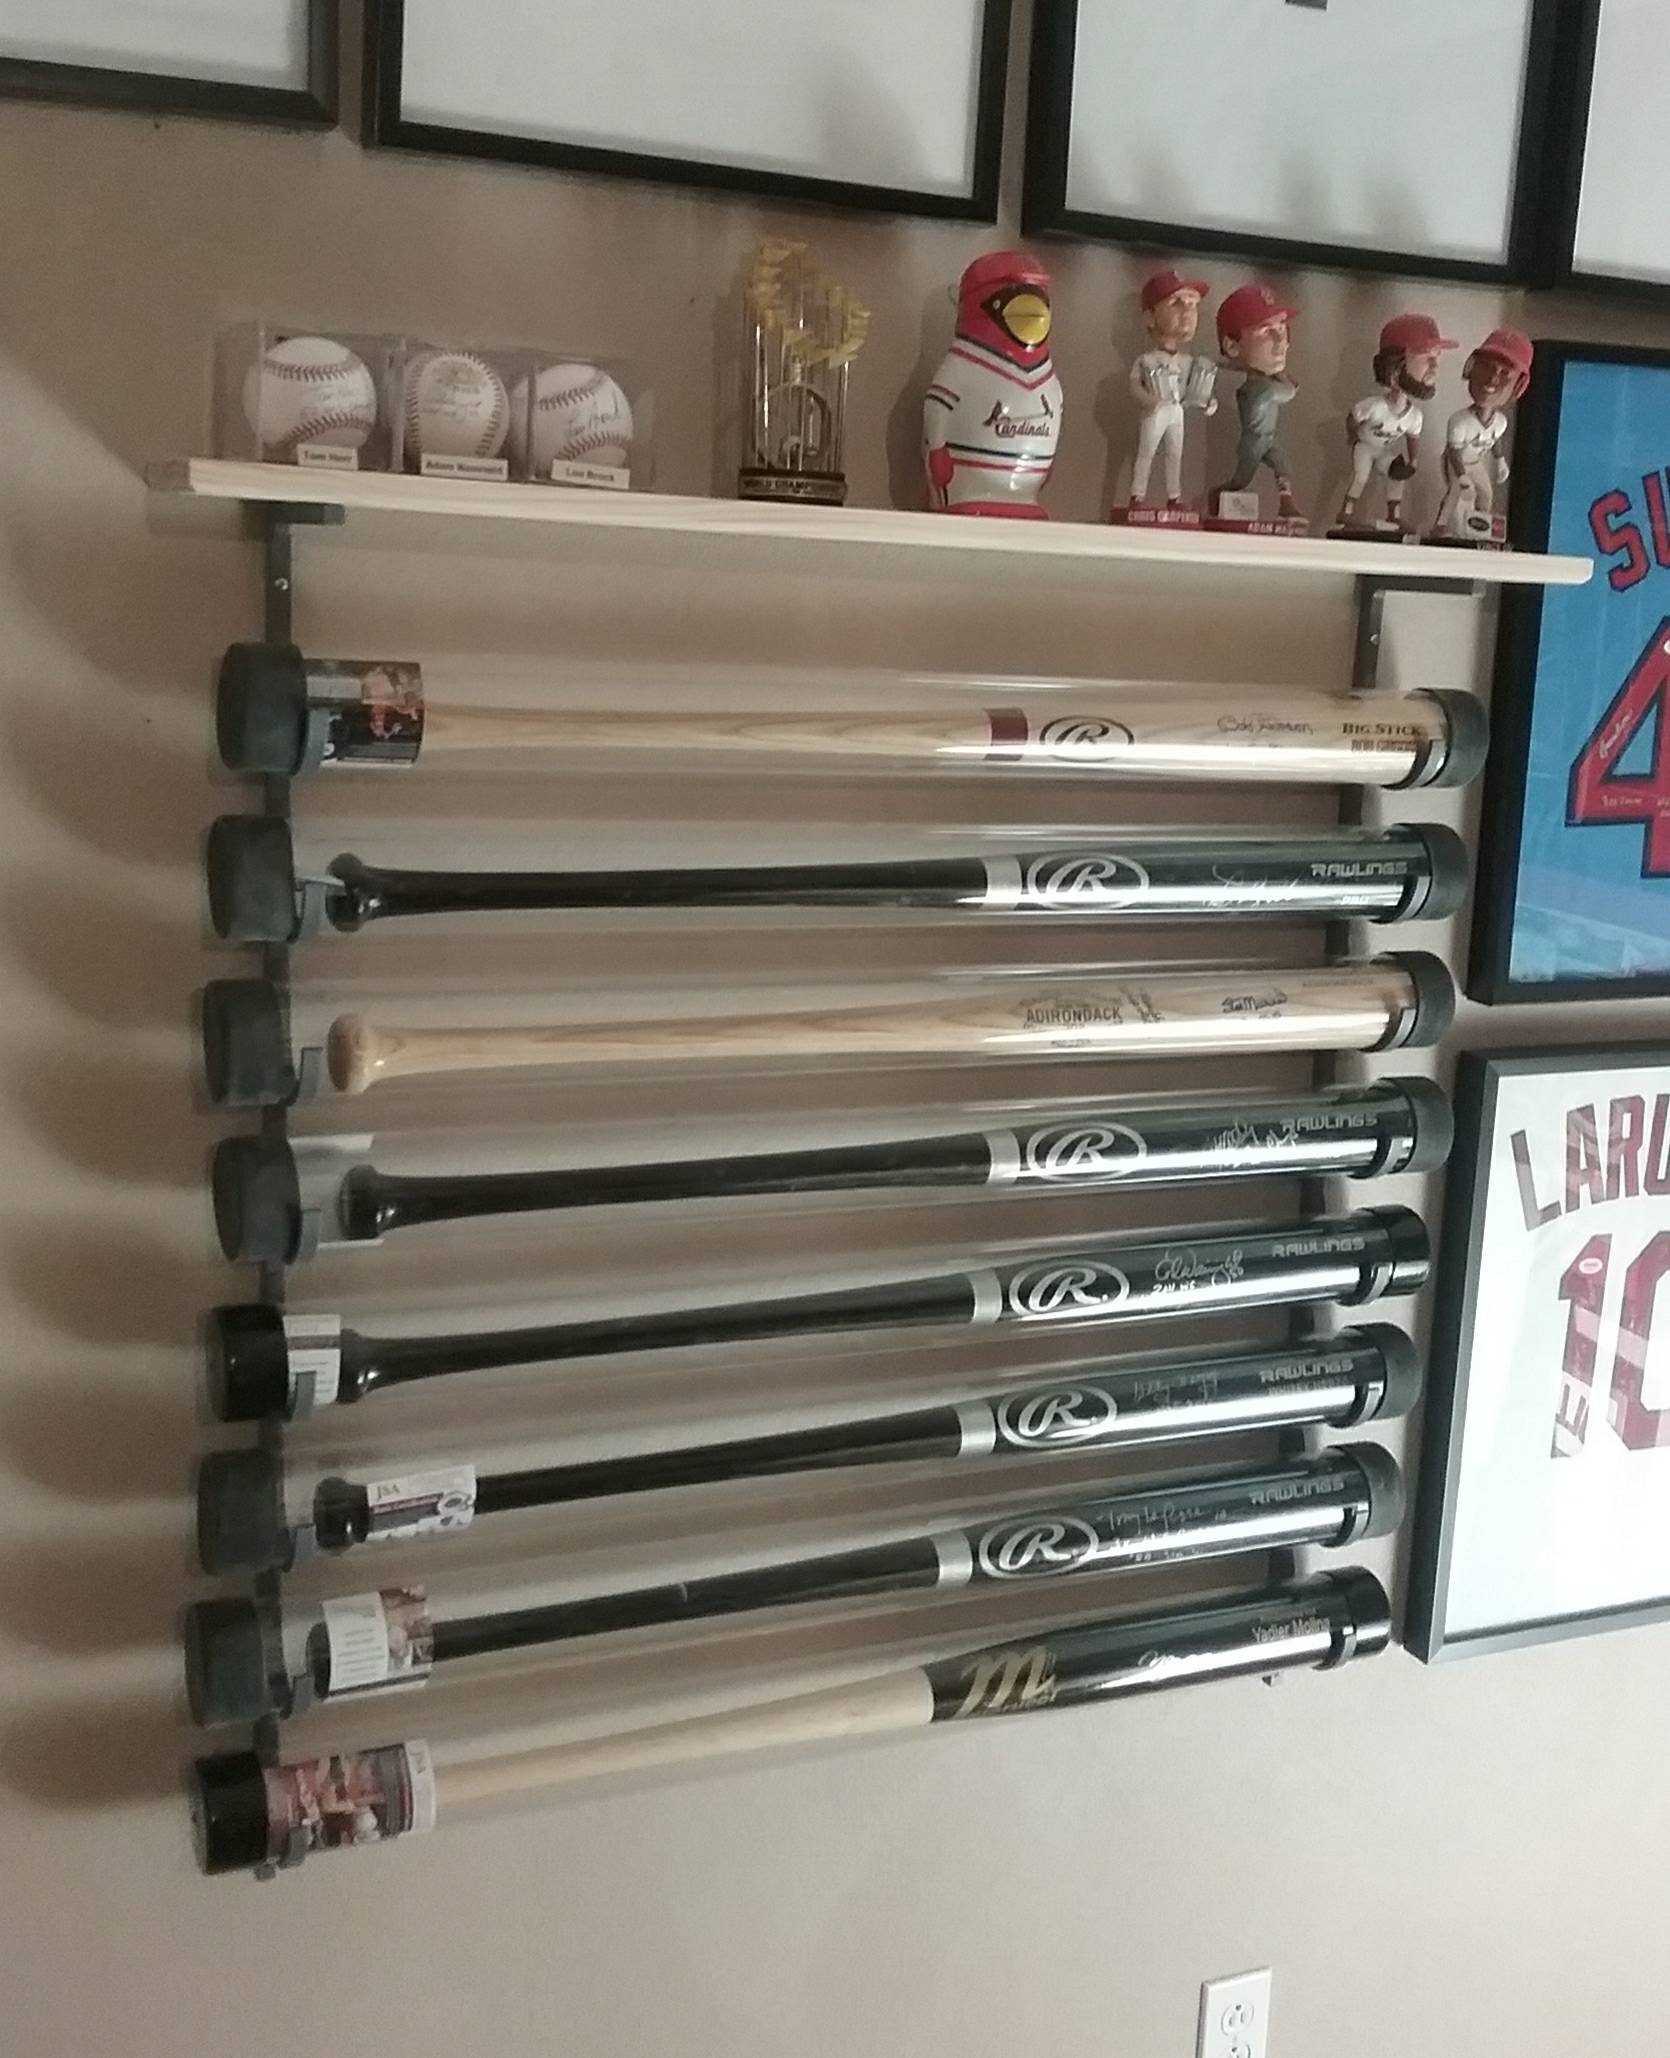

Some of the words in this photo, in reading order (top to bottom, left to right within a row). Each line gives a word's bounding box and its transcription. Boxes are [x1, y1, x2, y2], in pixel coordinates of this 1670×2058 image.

[995, 416, 1051, 439] Cardinals
[1310, 861, 1408, 878] RAWLINGS
[1026, 1006, 1123, 1024] ADIRONDACK
[1279, 1113, 1378, 1136] RAWLINGS
[1271, 1236, 1366, 1258] RAWLINGS
[1258, 1358, 1354, 1384] RAWLINGS
[1249, 1476, 1345, 1506] RAWLINGS
[1251, 1624, 1290, 1644] Yadier
